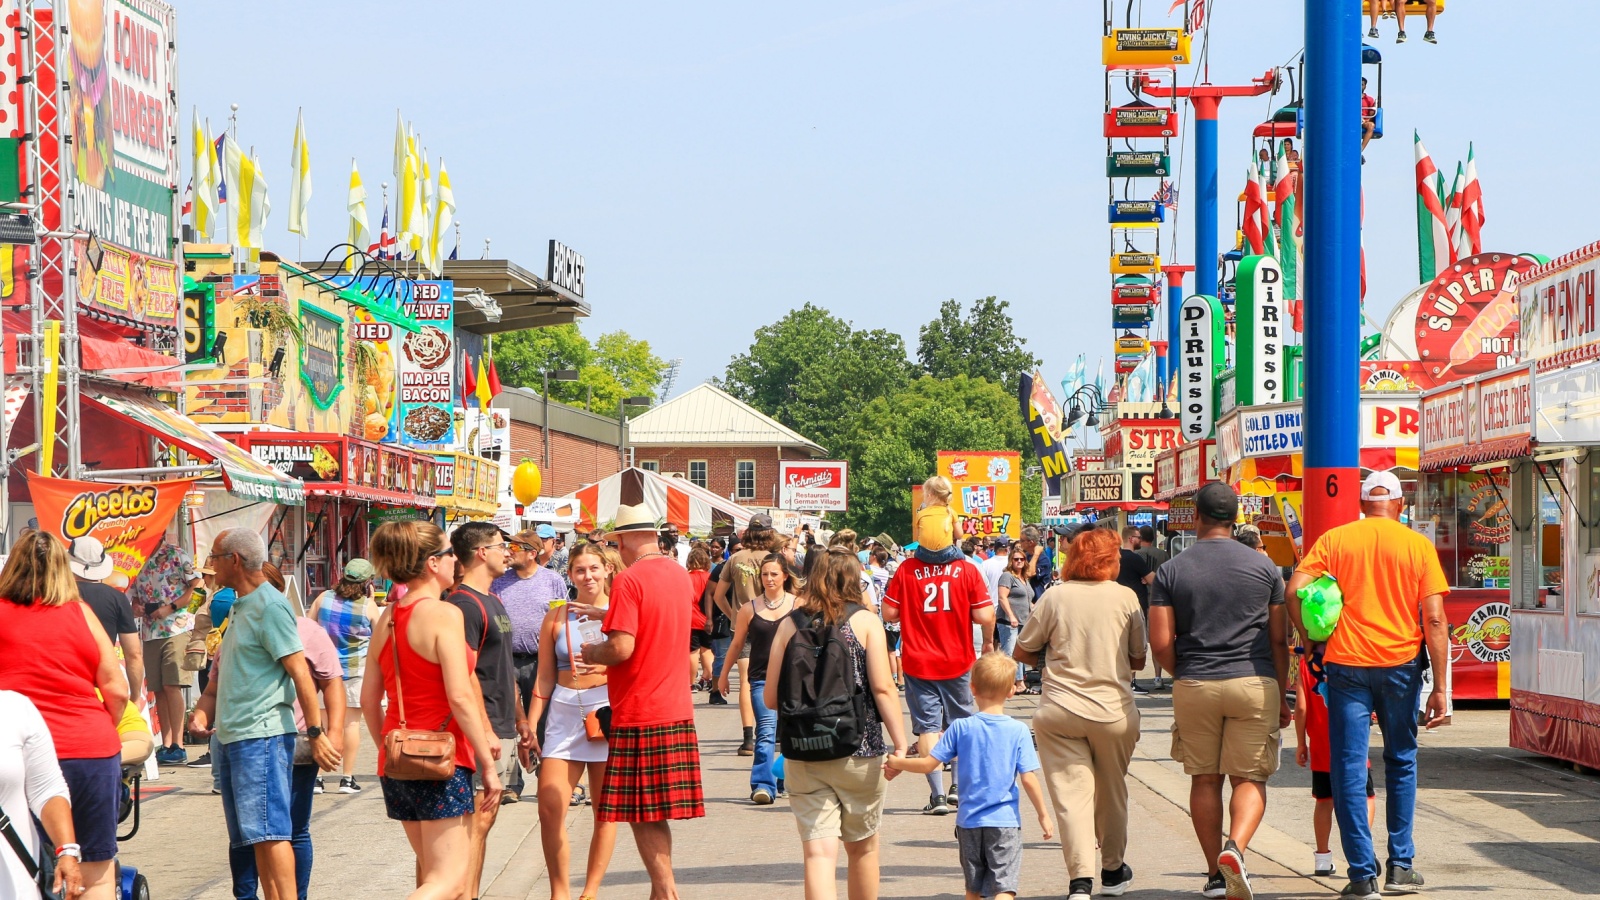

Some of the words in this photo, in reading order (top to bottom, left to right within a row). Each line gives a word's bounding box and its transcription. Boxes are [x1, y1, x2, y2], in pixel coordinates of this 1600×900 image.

[1118, 33, 1142, 41] LIVING
[1143, 33, 1166, 41] LUCKY
[112, 77, 165, 152] BURGER
[73, 177, 112, 241] DONUTS
[114, 197, 131, 247] ARE
[131, 203, 149, 253] THE
[151, 211, 168, 259] BUN
[553, 240, 586, 298] BRICKER
[413, 285, 439, 299] RED
[1428, 268, 1496, 332] SUPER
[404, 304, 450, 319] VELVET
[1541, 269, 1595, 347] FRENCH
[1261, 267, 1279, 405] DiRusso'
[1481, 337, 1511, 353] HOT
[403, 373, 449, 385] MAPLE
[1184, 306, 1205, 434] DiRusso's
[1369, 371, 1400, 385] FAMILY
[402, 389, 450, 402] BACON
[1483, 389, 1509, 432] CHEESE
[1511, 383, 1531, 426] FRIES
[1245, 414, 1270, 432] COLD
[1426, 403, 1447, 443] FRENCH
[1448, 399, 1464, 438] FRIES
[1245, 433, 1289, 453] BOTTLED
[251, 445, 314, 461] MEATBALL
[1129, 450, 1147, 459] Fresh
[786, 469, 832, 488] Schmidt's
[1081, 475, 1097, 488] ICE
[1098, 475, 1122, 487] COLD
[1326, 474, 1339, 498] 6
[1469, 476, 1510, 492] HANDMA
[966, 490, 992, 508] ICEE
[1084, 487, 1120, 501] DRINKS
[65, 486, 156, 538] Cheetos
[1169, 507, 1195, 515] CHEES
[97, 518, 128, 530] Crunchy
[119, 525, 145, 543] Hot
[914, 564, 962, 580] GREENE
[923, 581, 951, 613] 21
[1471, 604, 1510, 626] FAMIL
[790, 734, 834, 752] PUMA
